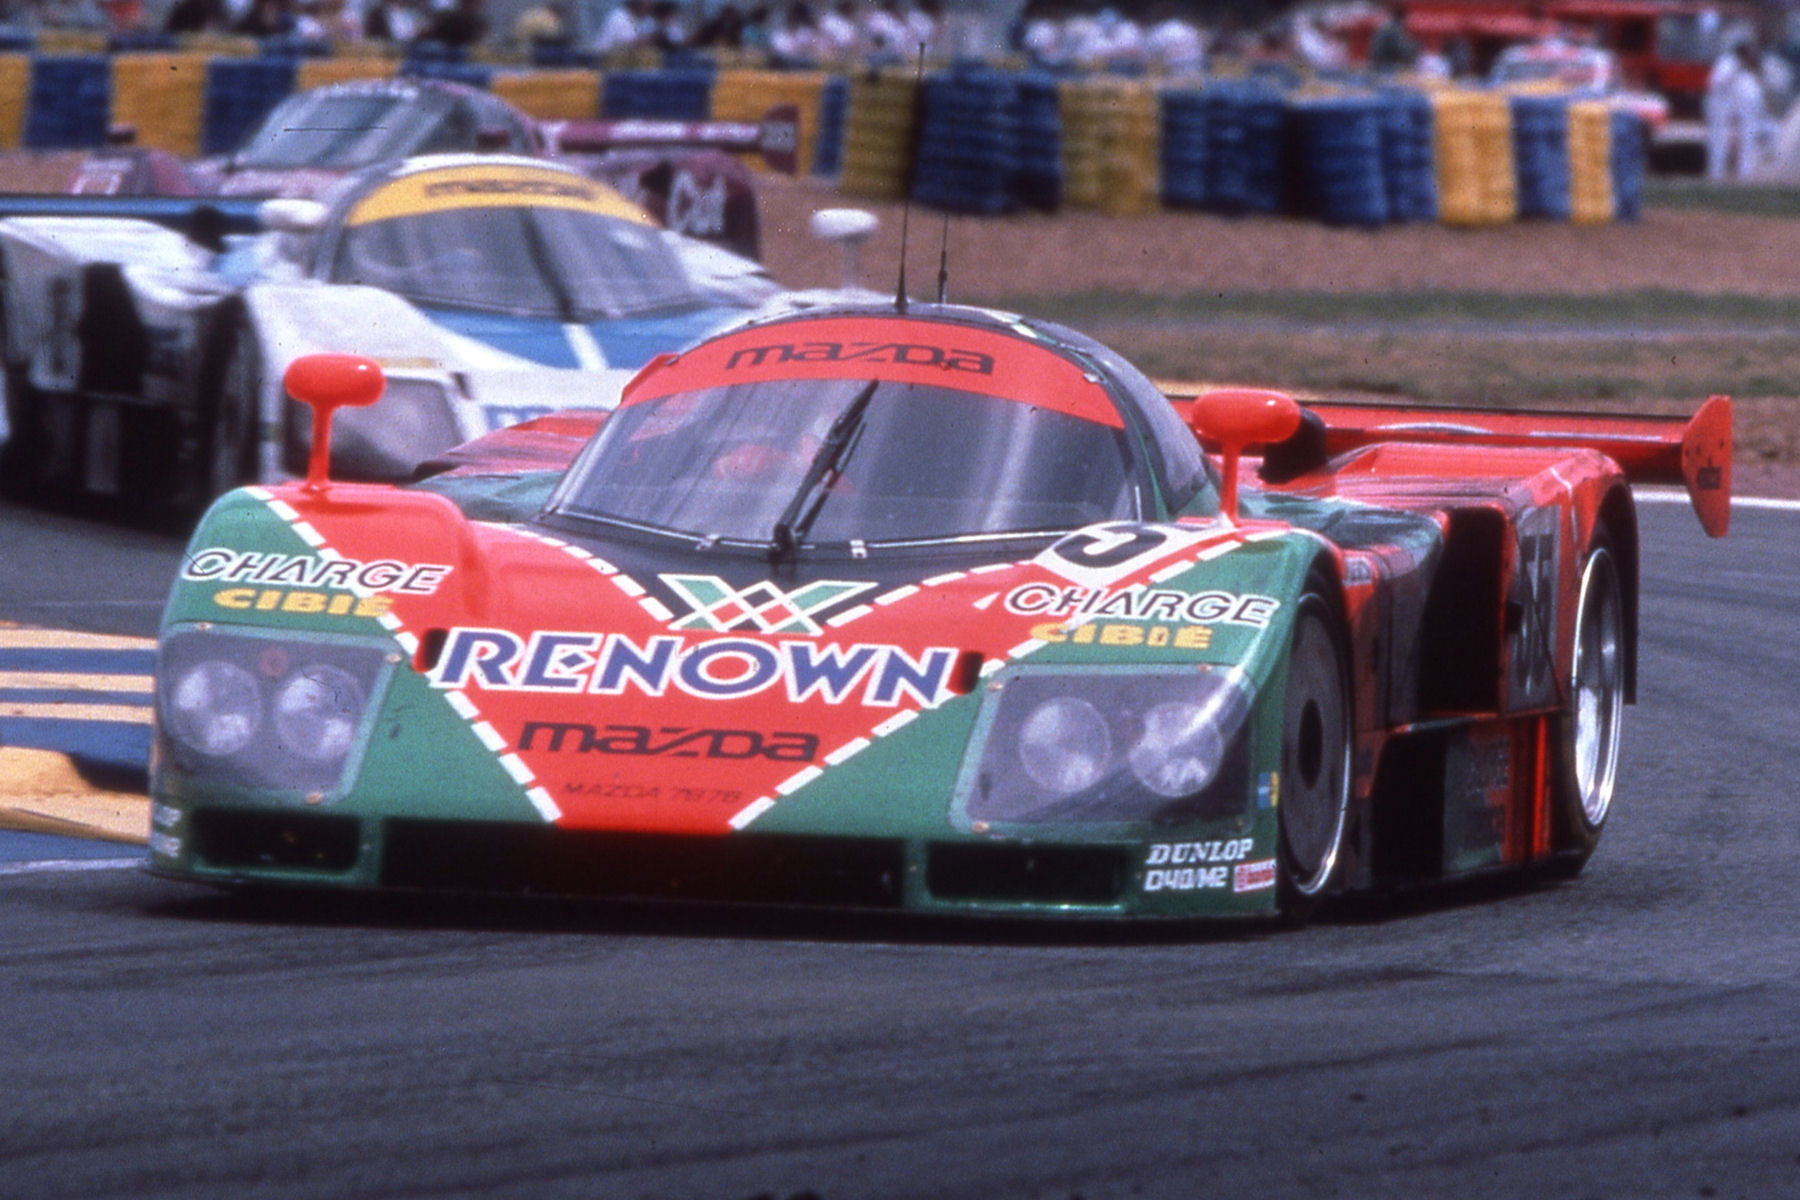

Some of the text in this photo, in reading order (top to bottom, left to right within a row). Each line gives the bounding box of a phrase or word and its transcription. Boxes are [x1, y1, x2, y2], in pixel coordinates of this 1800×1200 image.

[725, 342, 994, 375] mazda
[183, 549, 453, 594] CHARGE
[1004, 582, 1280, 628] CHARGE
[430, 627, 959, 709] RENOWN
[519, 721, 820, 762] mazda
[1145, 838, 1254, 865] DUNLOP
